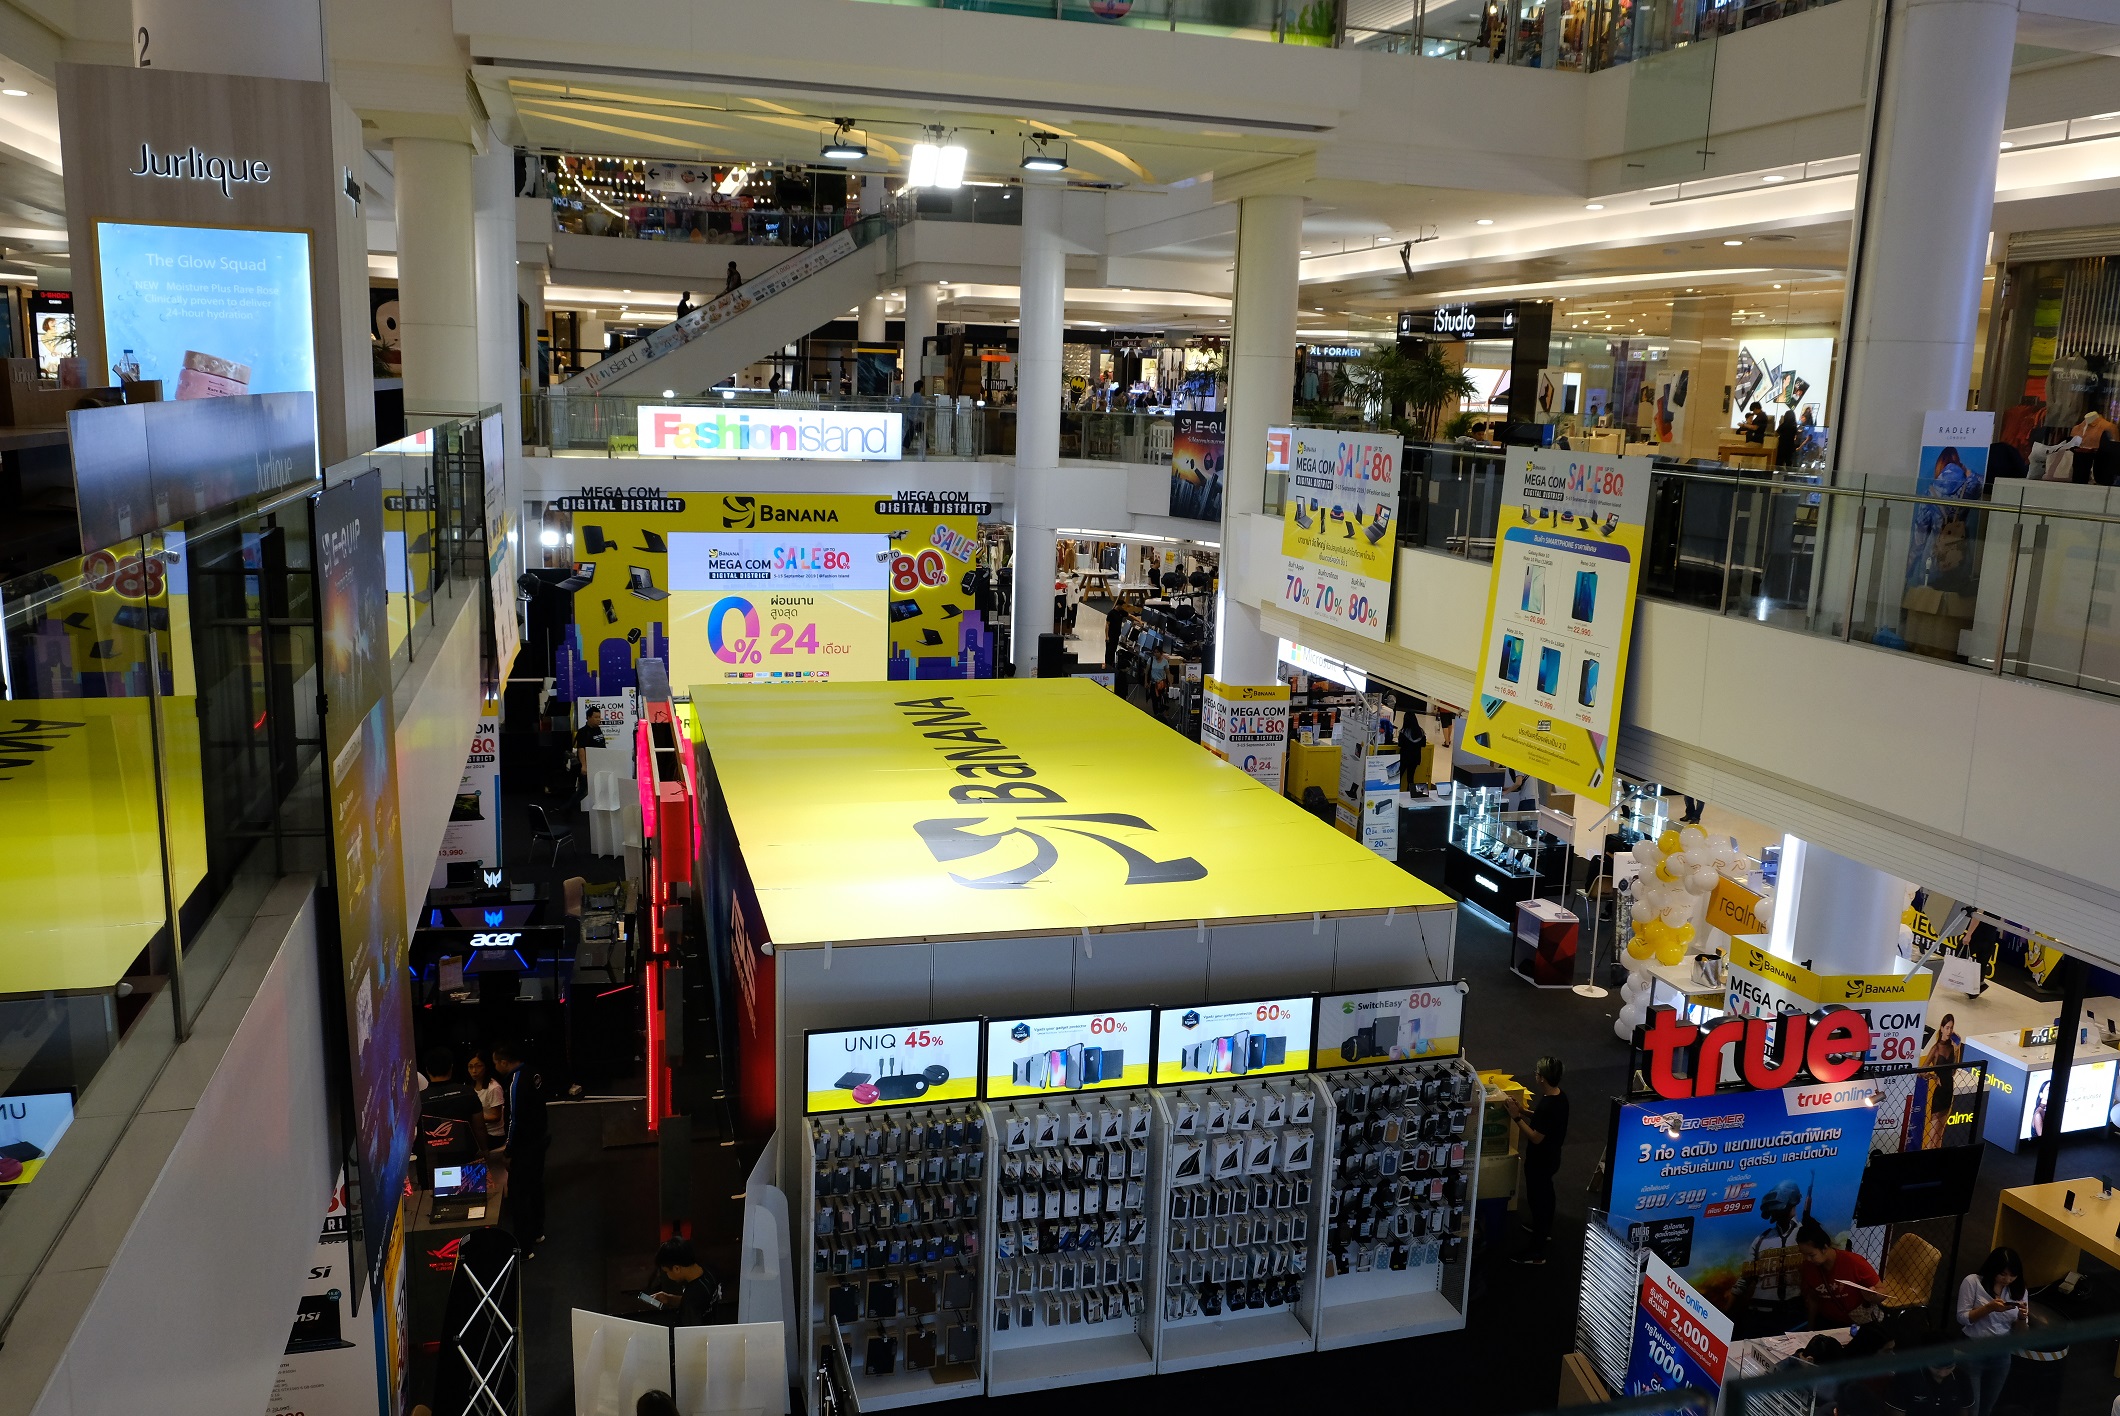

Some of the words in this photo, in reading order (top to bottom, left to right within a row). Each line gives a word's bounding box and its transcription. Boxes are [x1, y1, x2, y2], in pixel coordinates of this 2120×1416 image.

[137, 26, 150, 67] 2
[128, 143, 271, 199] Jurlique
[145, 253, 174, 268] The
[178, 255, 216, 269] Glow
[220, 257, 266, 273] Squad
[135, 281, 159, 290] NEW
[166, 282, 209, 292] Moisture
[211, 284, 231, 293] Plus
[233, 285, 254, 294] Rare
[256, 286, 279, 295] Rose
[144, 294, 188, 306] Clinically
[190, 296, 224, 306] proven
[227, 297, 237, 306] to
[239, 297, 271, 308] deliver
[166, 308, 204, 318] 24-hour
[207, 308, 253, 320] hydration
[1433, 306, 1475, 333] iStudio
[1310, 345, 1321, 356] XL
[1938, 426, 1976, 435] RADLEY
[1296, 457, 1317, 473] MEGA
[1318, 459, 1336, 475] COM
[1336, 442, 1373, 480] SALE
[1371, 452, 1392, 483] 80%
[255, 450, 293, 494] Jurlique
[1524, 473, 1546, 486] MEGA
[1548, 476, 1566, 489] COM
[1567, 463, 1604, 493] SALE
[1297, 475, 1313, 486] DIGITAL
[1313, 477, 1333, 489] DISTRICT
[1602, 472, 1624, 496] 80%
[581, 486, 624, 498] MEGA
[627, 487, 660, 498] COM
[897, 490, 935, 502] MEGA
[939, 491, 969, 502] COM
[1524, 488, 1542, 498] DIGITAL
[1542, 491, 1564, 501] DISTRICT
[562, 499, 616, 510] DIGITAL
[621, 499, 681, 511] DISTRICT
[879, 502, 928, 514] DIGITAL
[933, 503, 987, 514] DISTRICT
[932, 525, 975, 561] SALE
[1545, 537, 1574, 549] SMARTPHONE
[708, 559, 740, 570] MEGA
[745, 559, 771, 570] COM
[773, 547, 822, 570] SALE
[823, 551, 850, 570] 80%
[877, 552, 888, 561] UP
[889, 550, 900, 559] TO
[891, 551, 947, 591] 80%
[1285, 574, 1309, 606] 70%
[1315, 583, 1343, 616] 70%
[770, 595, 814, 605] ผ่อนนาน
[770, 608, 798, 620] สูงสุด
[1348, 593, 1378, 628] 80%
[707, 596, 762, 664] 0%
[769, 623, 819, 655] 24
[822, 642, 849, 654] เดือน
[1204, 696, 1217, 709] MEGA
[1217, 702, 1227, 715] COM
[1230, 707, 1260, 716] MEGA
[1263, 707, 1286, 716] COM
[1203, 706, 1217, 728] SALE
[1230, 717, 1264, 733] SALE
[1265, 719, 1285, 734] 80%
[1244, 755, 1257, 773] 0%
[1259, 761, 1271, 770] 24
[1719, 897, 1767, 934] realme
[469, 933, 522, 947] acer
[1408, 992, 1442, 1010] 80%
[1730, 975, 1771, 1010] MEGA
[1256, 1004, 1291, 1022] 60%
[1357, 999, 1403, 1011] SwitchEasy
[1090, 1016, 1128, 1035] 60%
[1879, 1013, 1921, 1029] COM
[844, 1033, 896, 1052] UNIQ
[904, 1029, 944, 1049] 45%
[1880, 1036, 1916, 1061] 80%
[1643, 1004, 1871, 1099] true
[1797, 1092, 1833, 1107] true
[1833, 1087, 1873, 1103] online
[1643, 1115, 1662, 1125] true
[1701, 1114, 1744, 1127] GAMER
[1638, 1143, 1652, 1164] 3
[1655, 1143, 1675, 1161] ท่อ
[1660, 1158, 1734, 1178] สำหรับเล่นเกม
[1723, 1202, 1741, 1213] 999
[1666, 1275, 1686, 1300] true
[1685, 1293, 1709, 1320] online
[1648, 1297, 1667, 1318] ส่วนลด
[1670, 1308, 1710, 1353] 2,000
[1708, 1350, 1719, 1364] บาท
[1648, 1339, 1685, 1383] 1000
[1753, 1350, 1770, 1370] Nice
